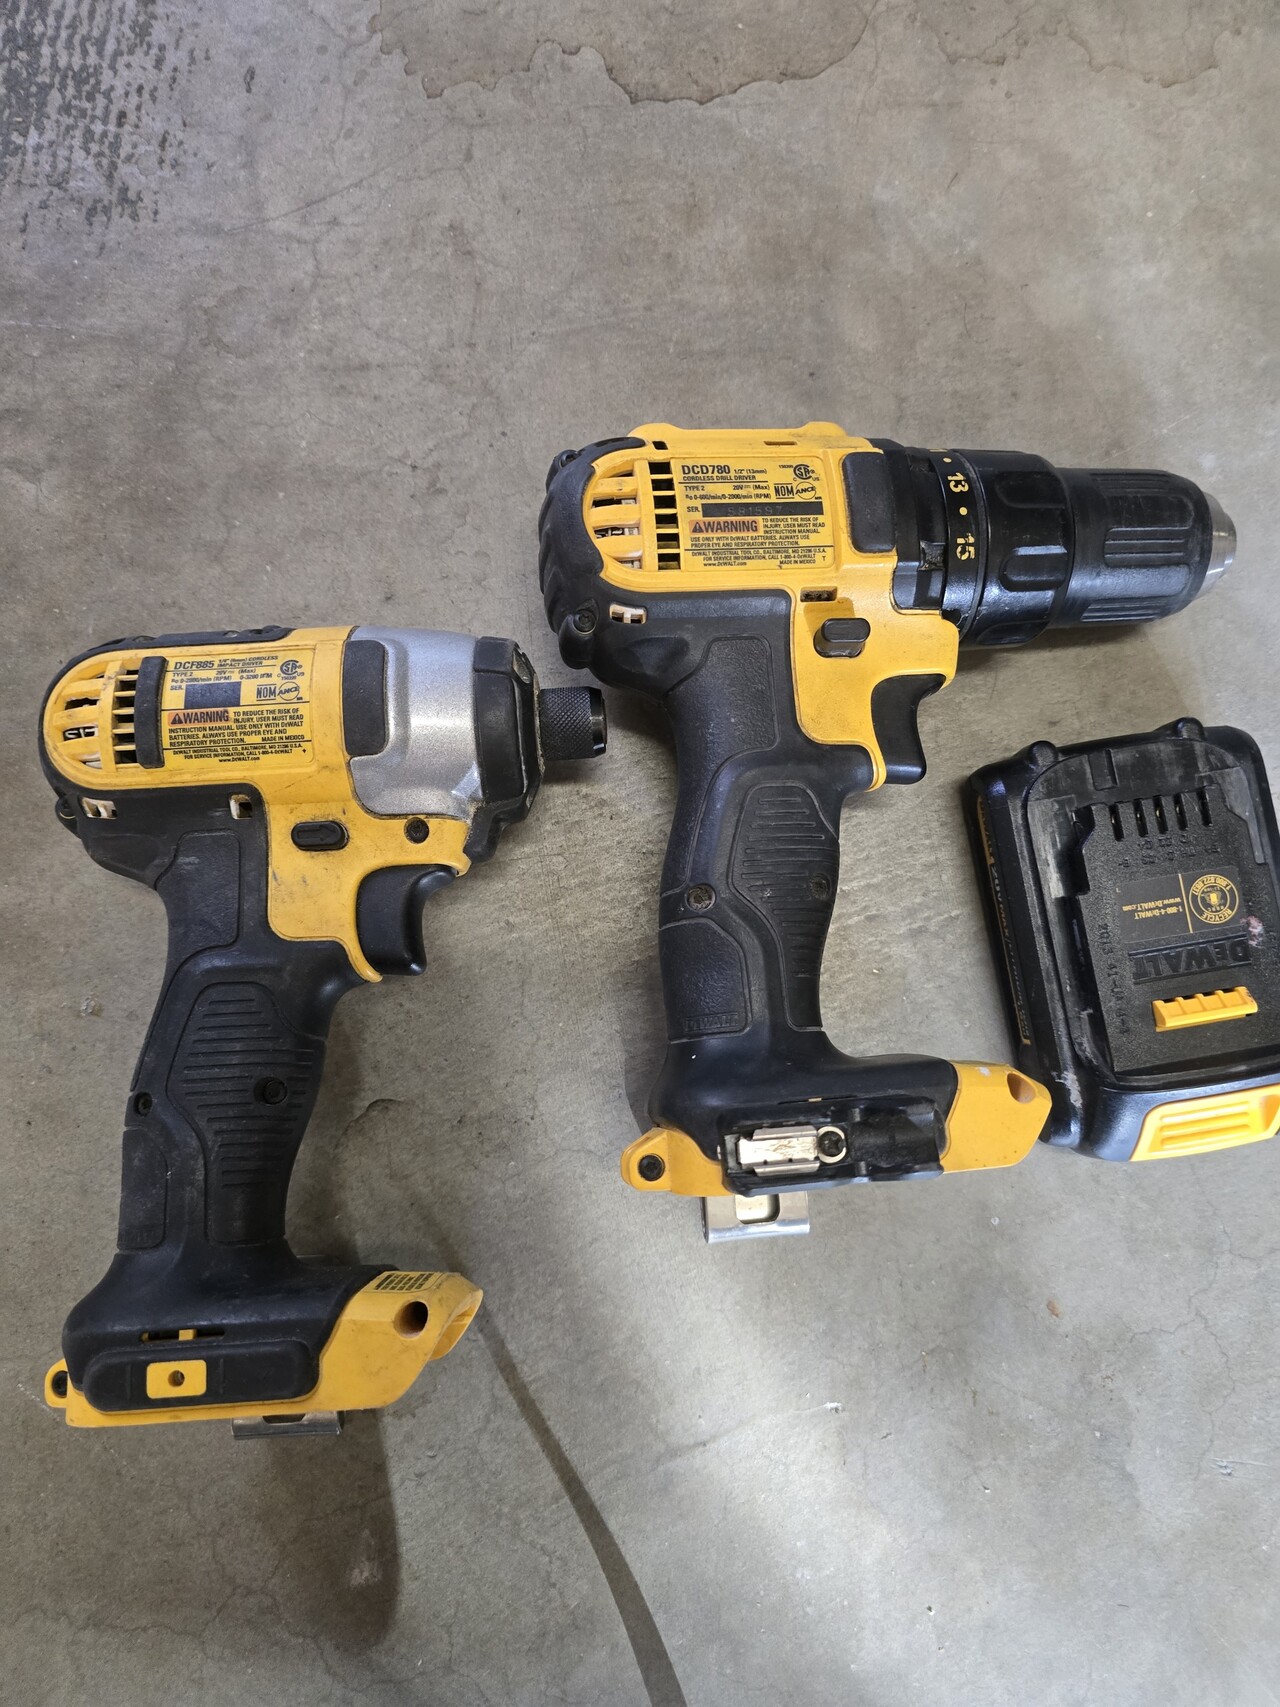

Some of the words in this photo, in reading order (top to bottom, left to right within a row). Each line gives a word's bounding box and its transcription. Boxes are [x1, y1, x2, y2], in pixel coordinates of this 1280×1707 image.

[681, 464, 731, 475] DCD780
[947, 472, 969, 493] 13
[774, 485, 795, 497] NOM
[795, 486, 816, 495] ANCE
[703, 520, 758, 533] WARNING
[956, 532, 975, 560] 15
[174, 661, 215, 670] DCF885
[256, 686, 276, 699] NOM
[183, 710, 229, 724] WARNING
[169, 740, 208, 748] RESPIRATORY
[1201, 908, 1233, 922] RECYCLE
